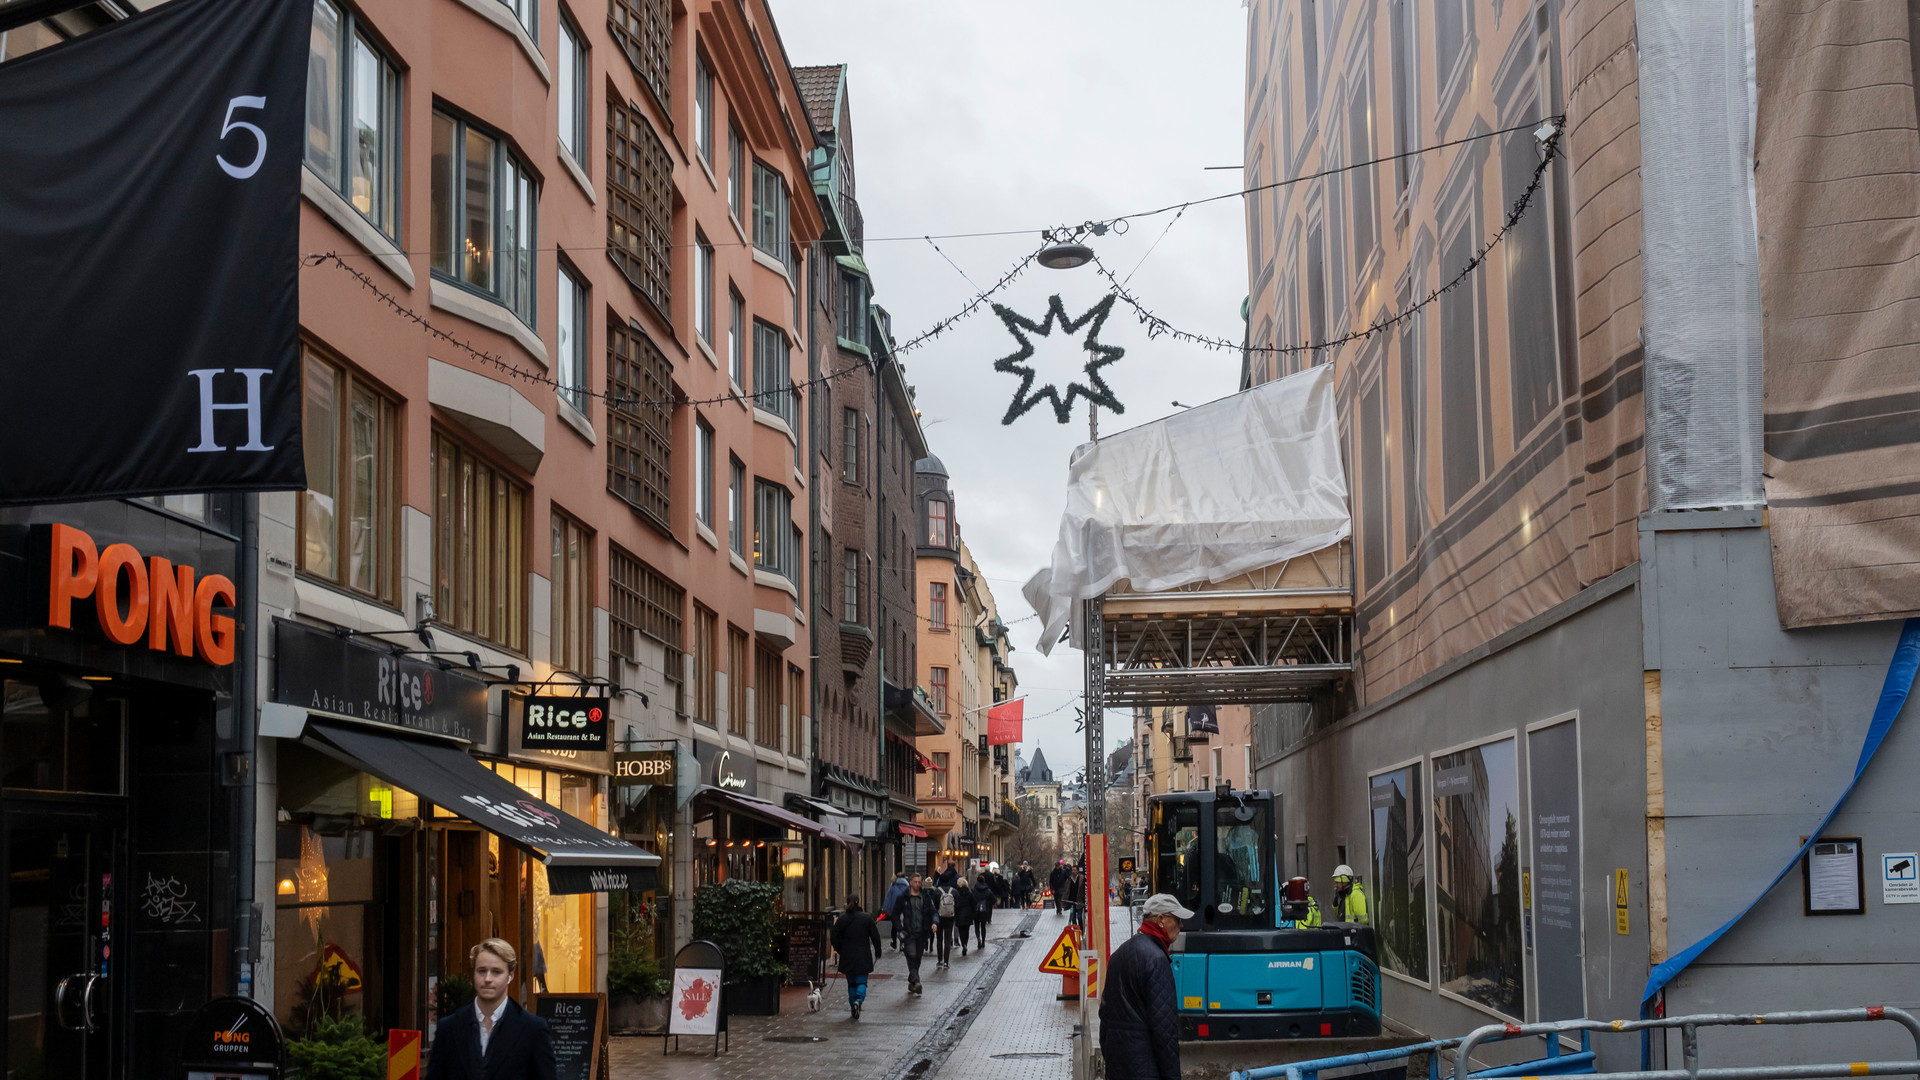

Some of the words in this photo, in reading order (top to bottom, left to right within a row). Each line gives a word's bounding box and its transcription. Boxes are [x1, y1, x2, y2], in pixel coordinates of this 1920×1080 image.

[216, 95, 267, 180] 5
[187, 368, 275, 453] H
[49, 523, 236, 666] PONG
[378, 657, 422, 711] Rice
[311, 689, 354, 714] Asian
[364, 701, 435, 731] Restaurant
[442, 718, 449, 734] &
[454, 721, 471, 738] Bar
[528, 704, 587, 728] Rice
[527, 732, 545, 740] Asian
[546, 732, 580, 741] Restaurant
[580, 733, 588, 741] &
[589, 733, 601, 741] Bar
[555, 1002, 582, 1014] Rice
[685, 992, 707, 1001] SALE
[213, 1044, 249, 1053] GRUPPEN
[214, 1030, 250, 1043] PONG
